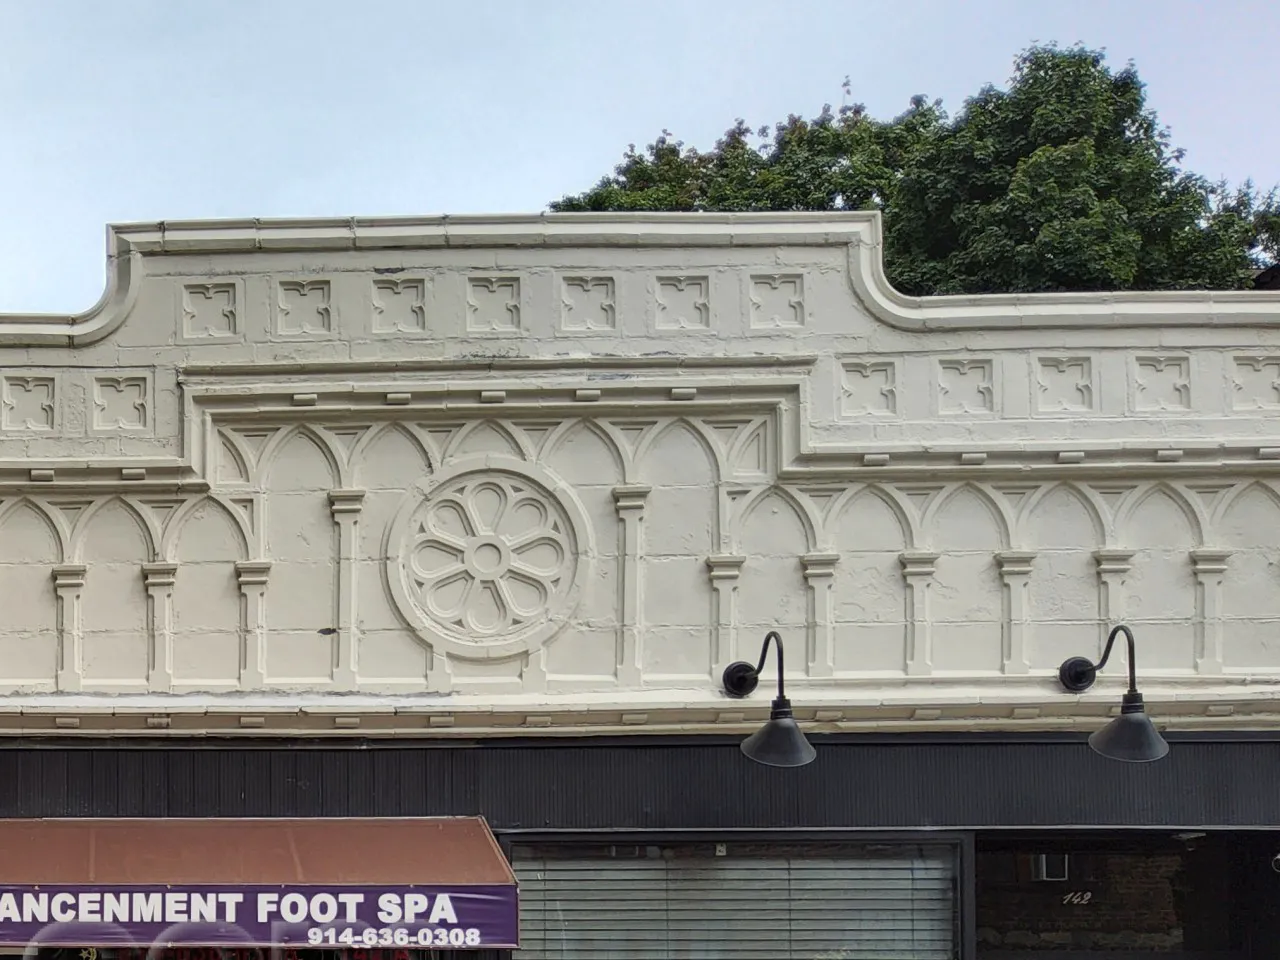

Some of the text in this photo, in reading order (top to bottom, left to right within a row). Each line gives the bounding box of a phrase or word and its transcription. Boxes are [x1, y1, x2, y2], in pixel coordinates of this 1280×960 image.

[1063, 892, 1092, 904] 142
[257, 893, 364, 923] FOOT
[377, 893, 458, 923] SPA
[307, 928, 481, 946] 914-636-0308
